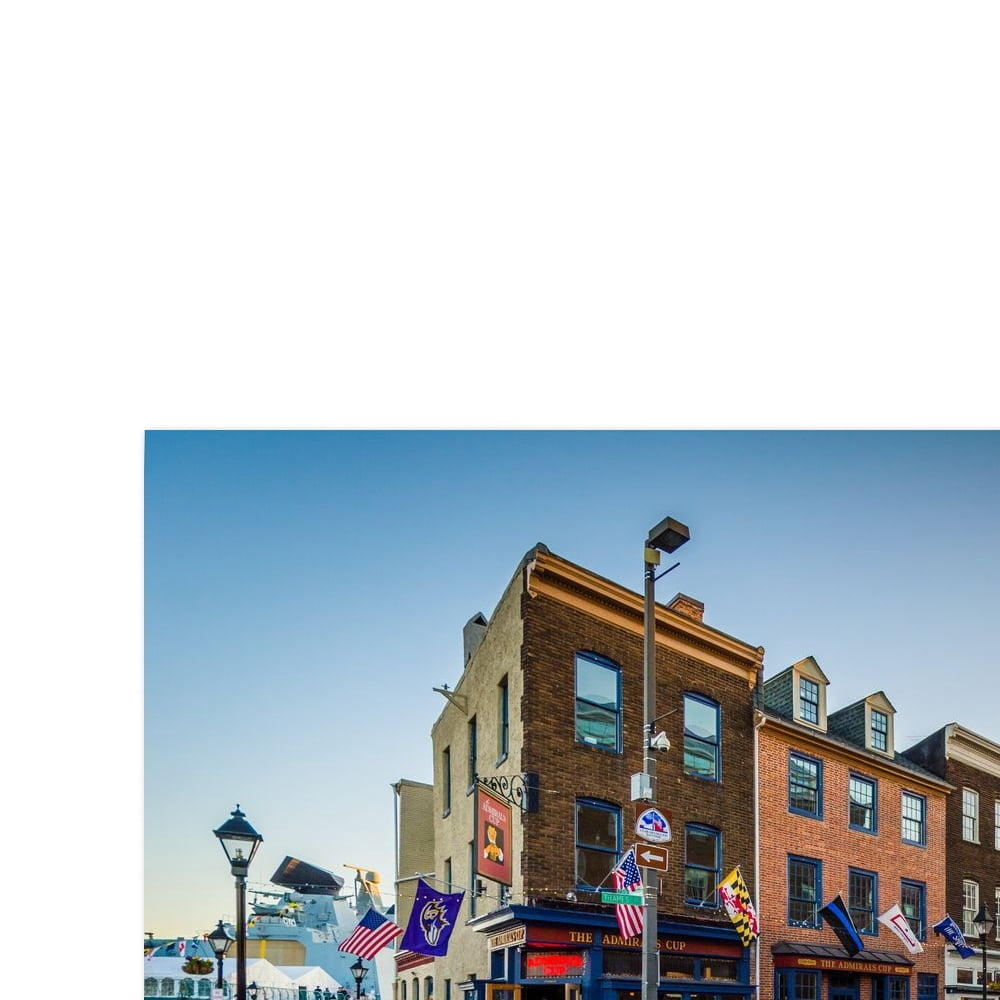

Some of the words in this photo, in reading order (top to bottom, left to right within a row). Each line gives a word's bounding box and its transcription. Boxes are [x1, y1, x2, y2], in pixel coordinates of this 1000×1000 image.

[568, 931, 593, 943] THE
[602, 934, 661, 949] ADMIRS
[665, 939, 686, 951] CUP
[820, 959, 836, 968] THE
[839, 960, 877, 971] ADMIRALS
[877, 964, 892, 973] CUP
